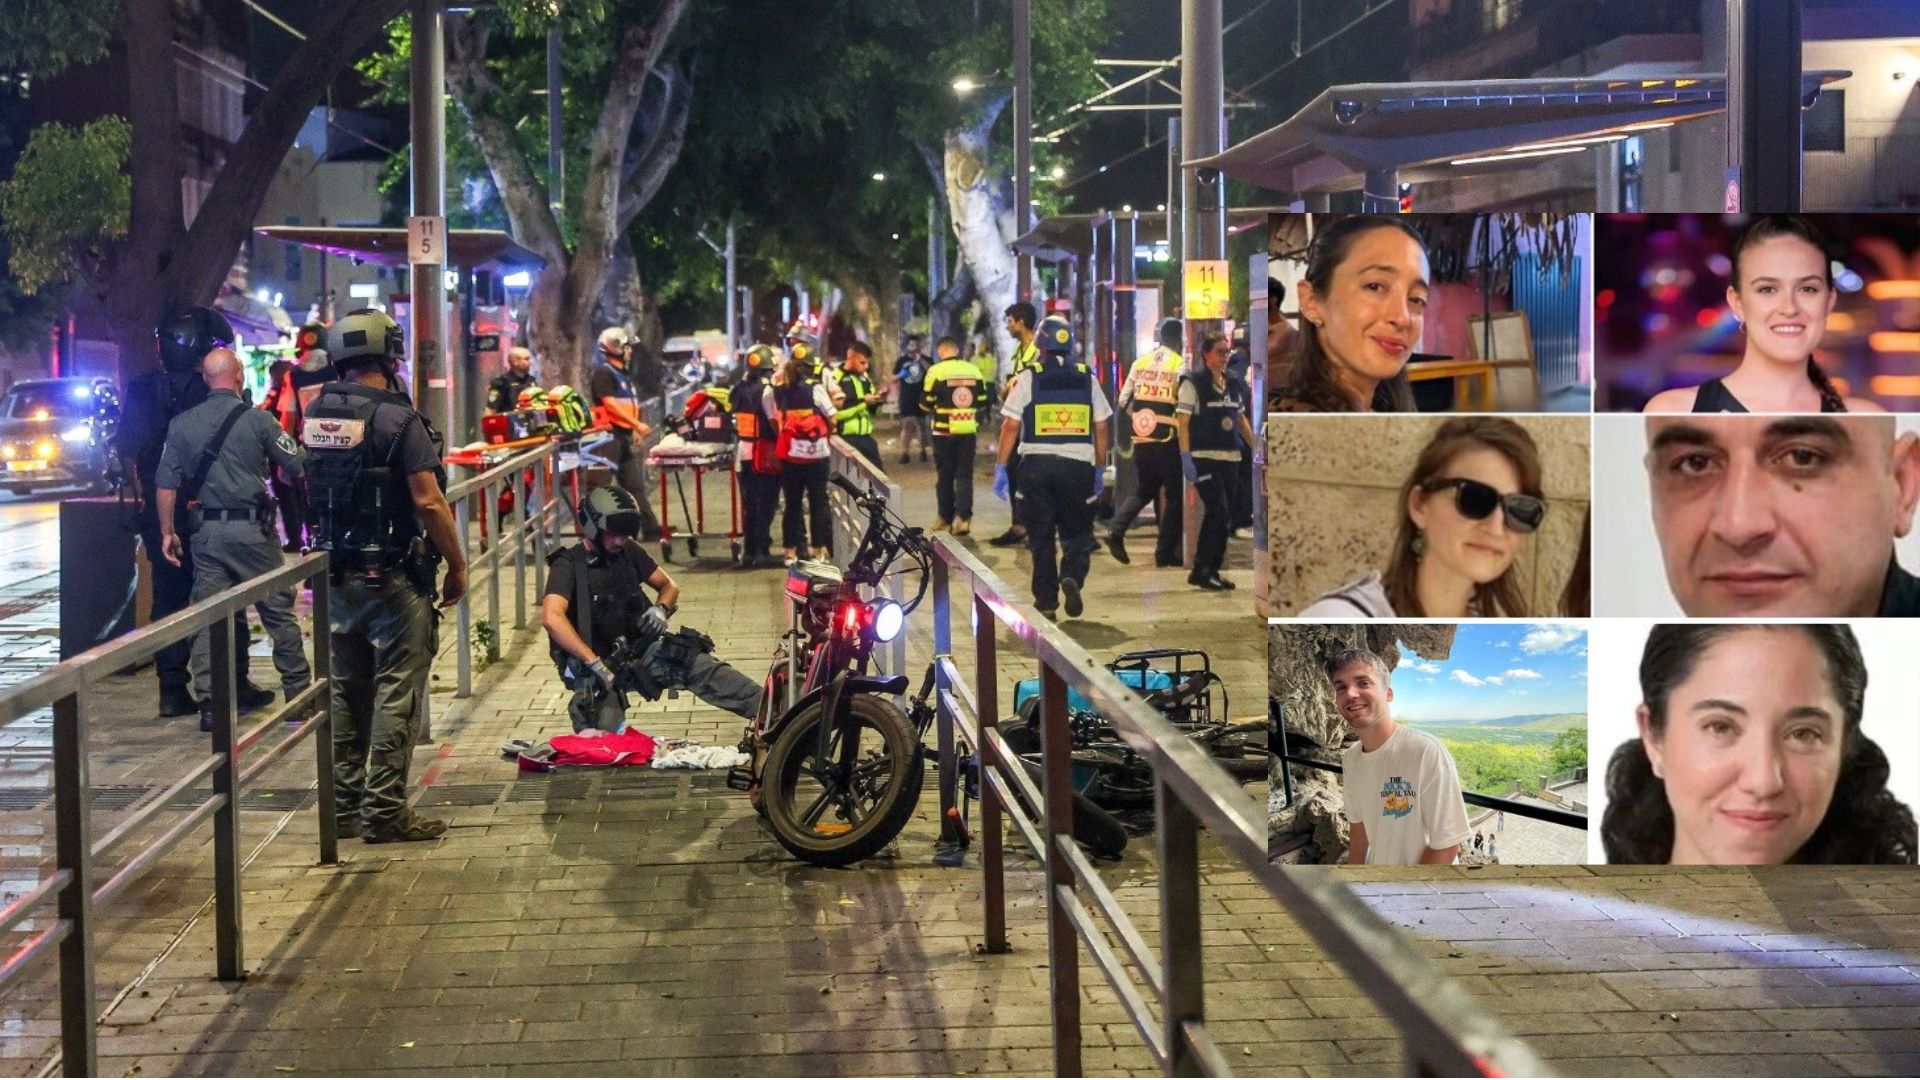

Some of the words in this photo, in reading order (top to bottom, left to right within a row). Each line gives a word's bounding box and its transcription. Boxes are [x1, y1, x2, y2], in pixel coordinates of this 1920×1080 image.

[420, 220, 433, 235] 11
[422, 239, 430, 254] 5
[1199, 266, 1214, 283] 11
[1202, 288, 1211, 306] 5
[312, 433, 330, 443] חבלה
[334, 435, 351, 445] קצין
